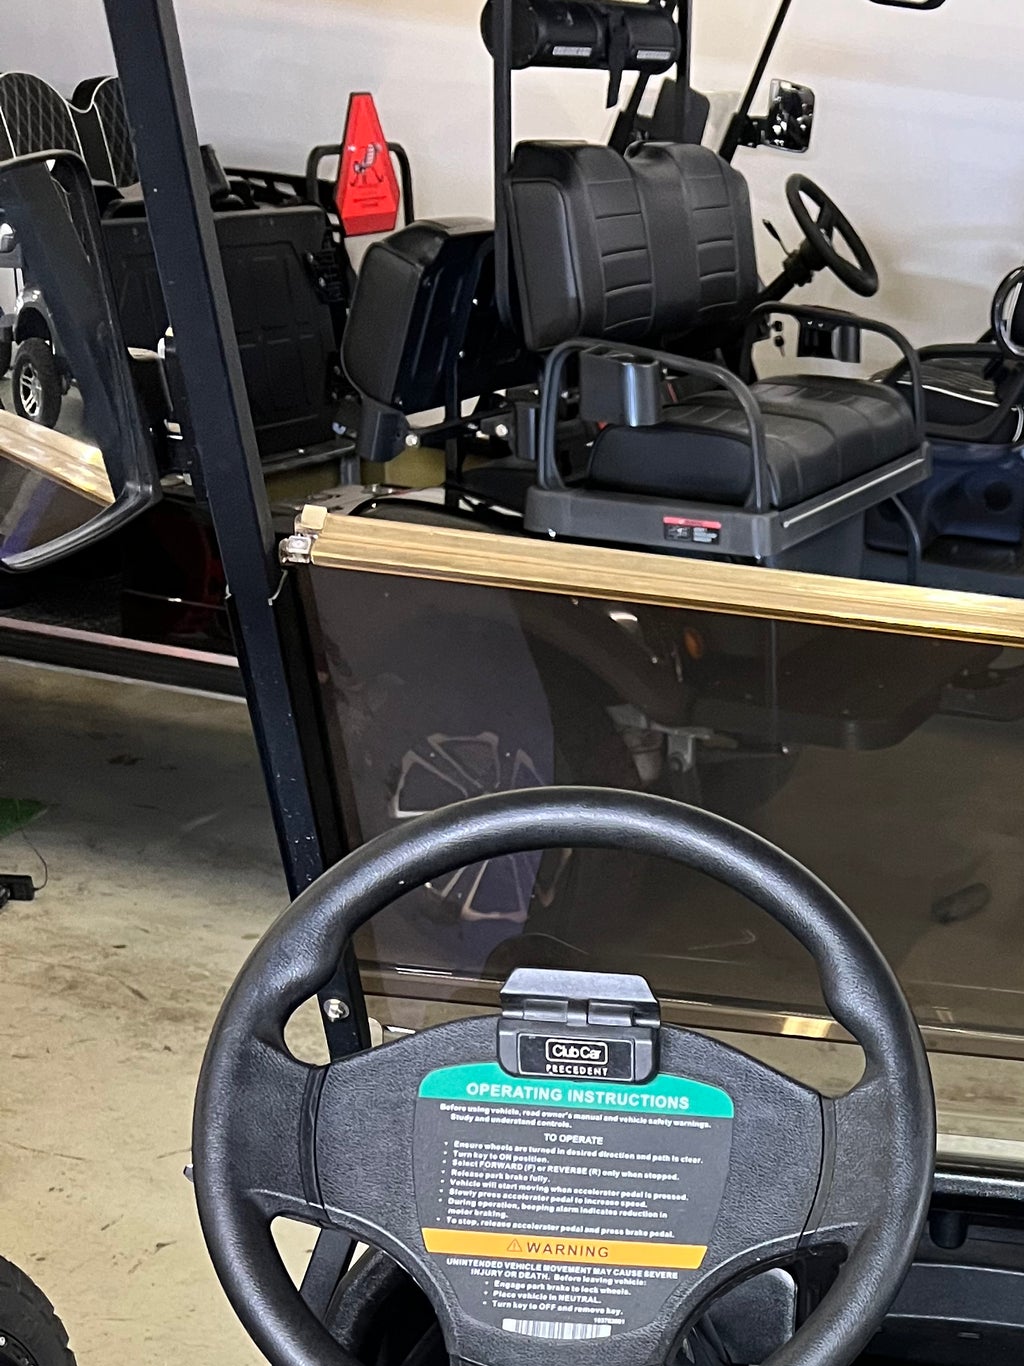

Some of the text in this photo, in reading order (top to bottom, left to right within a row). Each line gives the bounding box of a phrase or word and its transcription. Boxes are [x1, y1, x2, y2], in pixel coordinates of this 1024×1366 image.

[545, 1064, 608, 1076] PRECEDENT
[466, 1083, 689, 1107] OPERATING INSTRUCTIONS
[439, 1103, 466, 1112] Before
[467, 1106, 490, 1114] using
[618, 1116, 647, 1124] vehicle
[648, 1118, 672, 1127] safety
[450, 1112, 474, 1122] Study
[490, 1117, 536, 1125] understand
[543, 1132, 603, 1145] TO OPERATE
[452, 1149, 472, 1158] Turn
[473, 1151, 488, 1160] key
[489, 1152, 498, 1160] to
[512, 1155, 549, 1163] position.
[453, 1140, 483, 1149] Ensure
[483, 1143, 513, 1151] wheels
[528, 1146, 556, 1154] turned
[566, 1148, 597, 1157] desired
[598, 1150, 635, 1159] direction
[651, 1154, 670, 1162] path
[450, 1168, 484, 1178] Release
[504, 1172, 528, 1181] brake
[529, 1174, 550, 1184] fully.
[452, 1158, 478, 1167] Select
[478, 1160, 523, 1170] FORWARD
[523, 1163, 536, 1172] (F)
[546, 1165, 587, 1174] REVERSE
[588, 1168, 601, 1176] (R)
[601, 1169, 620, 1178] only
[620, 1170, 643, 1178] when
[643, 1172, 679, 1180] stopped.
[449, 1178, 481, 1187] Vehicle
[497, 1182, 517, 1190] start
[518, 1184, 549, 1193] moving
[573, 1188, 620, 1196] accelerator
[620, 1190, 643, 1198] pedal
[644, 1191, 652, 1199] is
[448, 1187, 477, 1198] Slowly
[502, 1193, 550, 1201] accelerator
[574, 1196, 583, 1204] to
[584, 1197, 620, 1206] increase
[620, 1200, 648, 1208] speed.
[521, 1203, 555, 1213] beeping
[579, 1206, 618, 1215] indicates
[618, 1210, 658, 1218] reduction
[446, 1215, 457, 1224] To
[480, 1220, 511, 1228] release
[512, 1222, 560, 1230] accelerator
[583, 1226, 600, 1234] and
[624, 1228, 648, 1236] brake
[648, 1230, 674, 1238] pedal.
[526, 1242, 608, 1257] WARNING
[446, 1258, 678, 1279] UNINTENDED VEHICLE MOVEMENT MAY CAUSE SEVERE
[470, 1268, 503, 1276] INJURY
[503, 1270, 517, 1278] OR
[518, 1271, 550, 1280] DEATH.
[553, 1273, 581, 1282] Before
[582, 1275, 613, 1285] leaving
[493, 1279, 525, 1290] Engage
[546, 1283, 570, 1291] brake
[599, 1287, 631, 1295] wheels.
[492, 1290, 516, 1298] Place
[517, 1292, 548, 1300] vehicle
[558, 1294, 602, 1303] NEUTRAL.
[492, 1299, 512, 1308] Turn
[512, 1301, 528, 1310] key
[528, 1302, 538, 1310] to
[538, 1302, 556, 1310] OFF
[573, 1306, 605, 1314] remove
